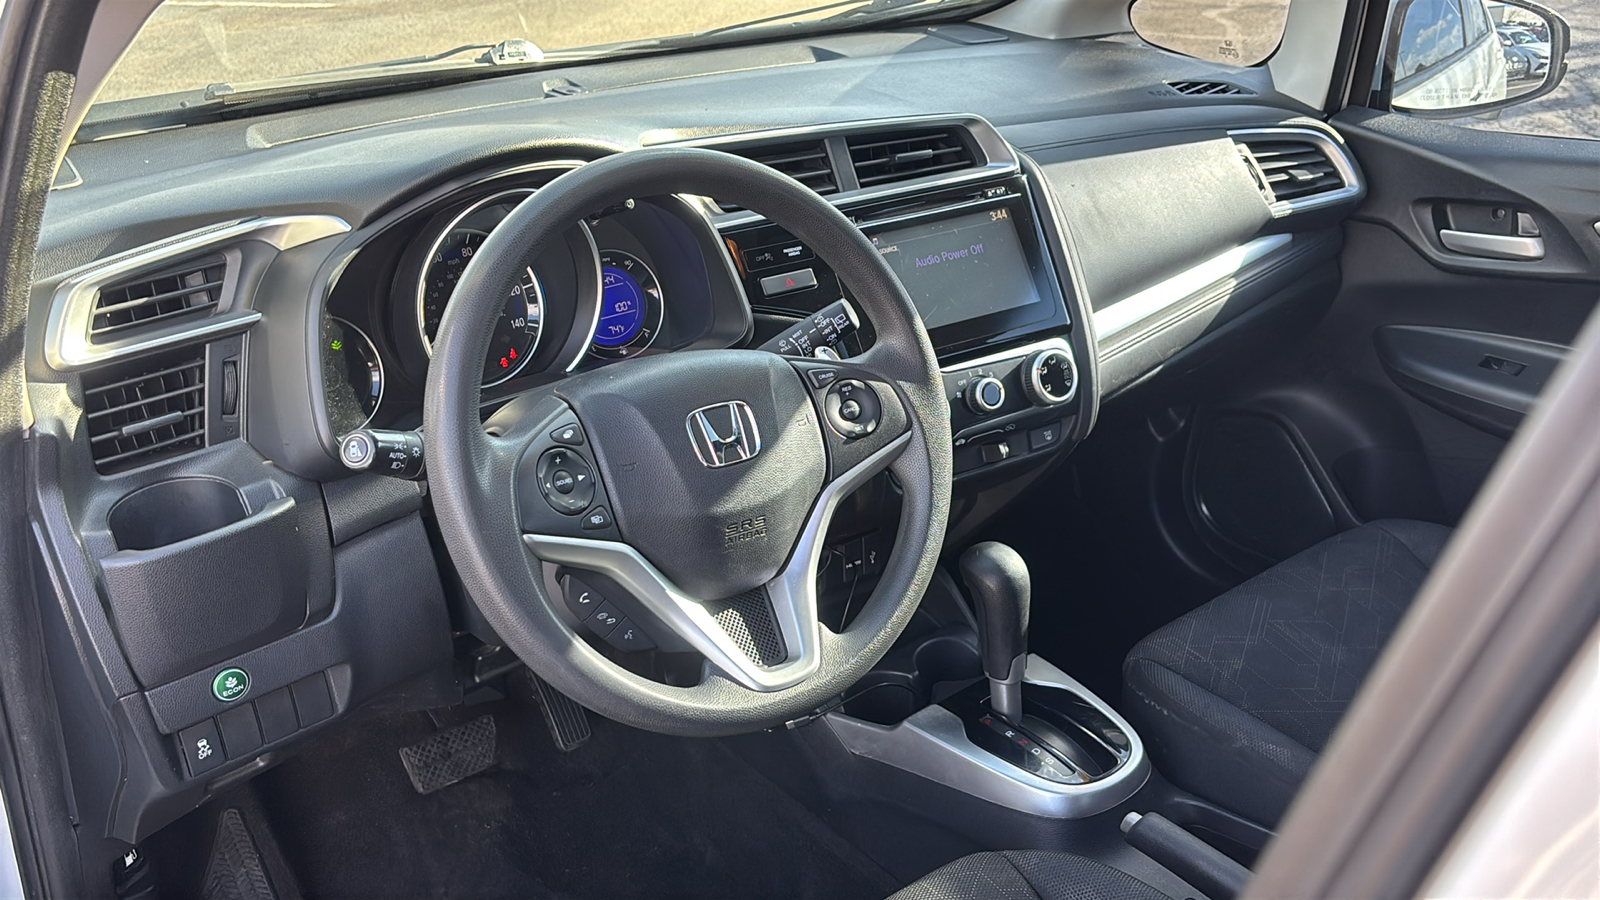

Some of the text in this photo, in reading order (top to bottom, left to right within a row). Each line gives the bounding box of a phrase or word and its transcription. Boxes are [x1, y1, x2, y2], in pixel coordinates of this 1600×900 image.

[990, 209, 1007, 221] 3:44
[461, 247, 473, 257] 80
[915, 243, 984, 267] Audio Power Off
[511, 317, 525, 329] 140
[820, 318, 831, 327] OFF
[838, 320, 850, 330] REAR
[824, 326, 833, 334] INT
[798, 335, 809, 345] OFF
[828, 333, 837, 341] ON
[780, 345, 792, 353] PULL
[802, 340, 811, 349] INT
[726, 515, 766, 534] SRS
[222, 684, 244, 697] ECON
[1005, 730, 1015, 738] R
[1031, 747, 1041, 755] D
[1045, 757, 1054, 765] S
